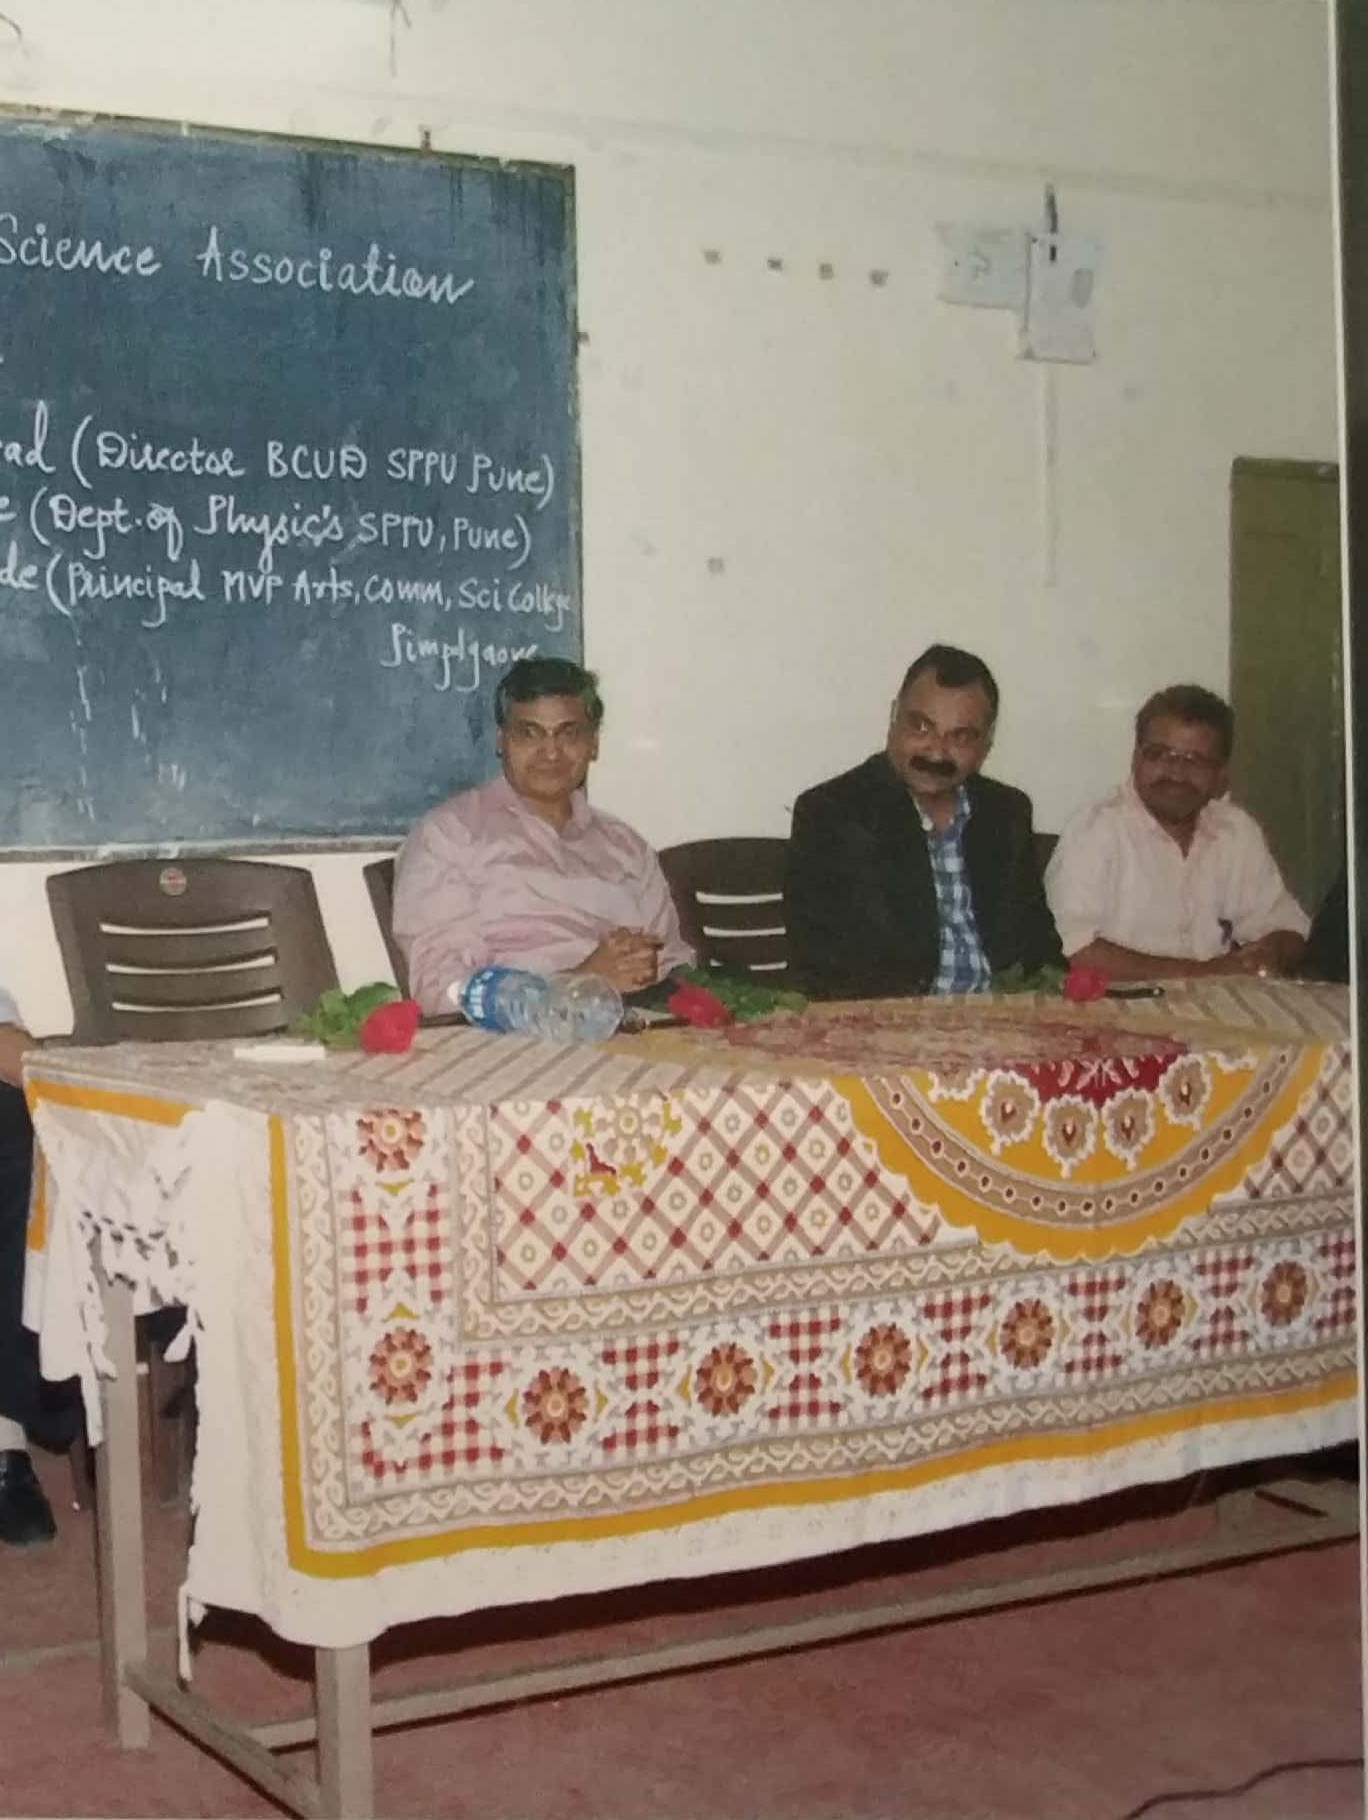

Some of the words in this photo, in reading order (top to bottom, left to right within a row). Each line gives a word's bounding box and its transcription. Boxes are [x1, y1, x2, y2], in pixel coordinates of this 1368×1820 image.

[197, 225, 476, 304] Association
[267, 441, 367, 480] BCUD
[387, 448, 457, 486] SPPU
[466, 454, 555, 511] Pune)
[458, 577, 503, 612] Sci
